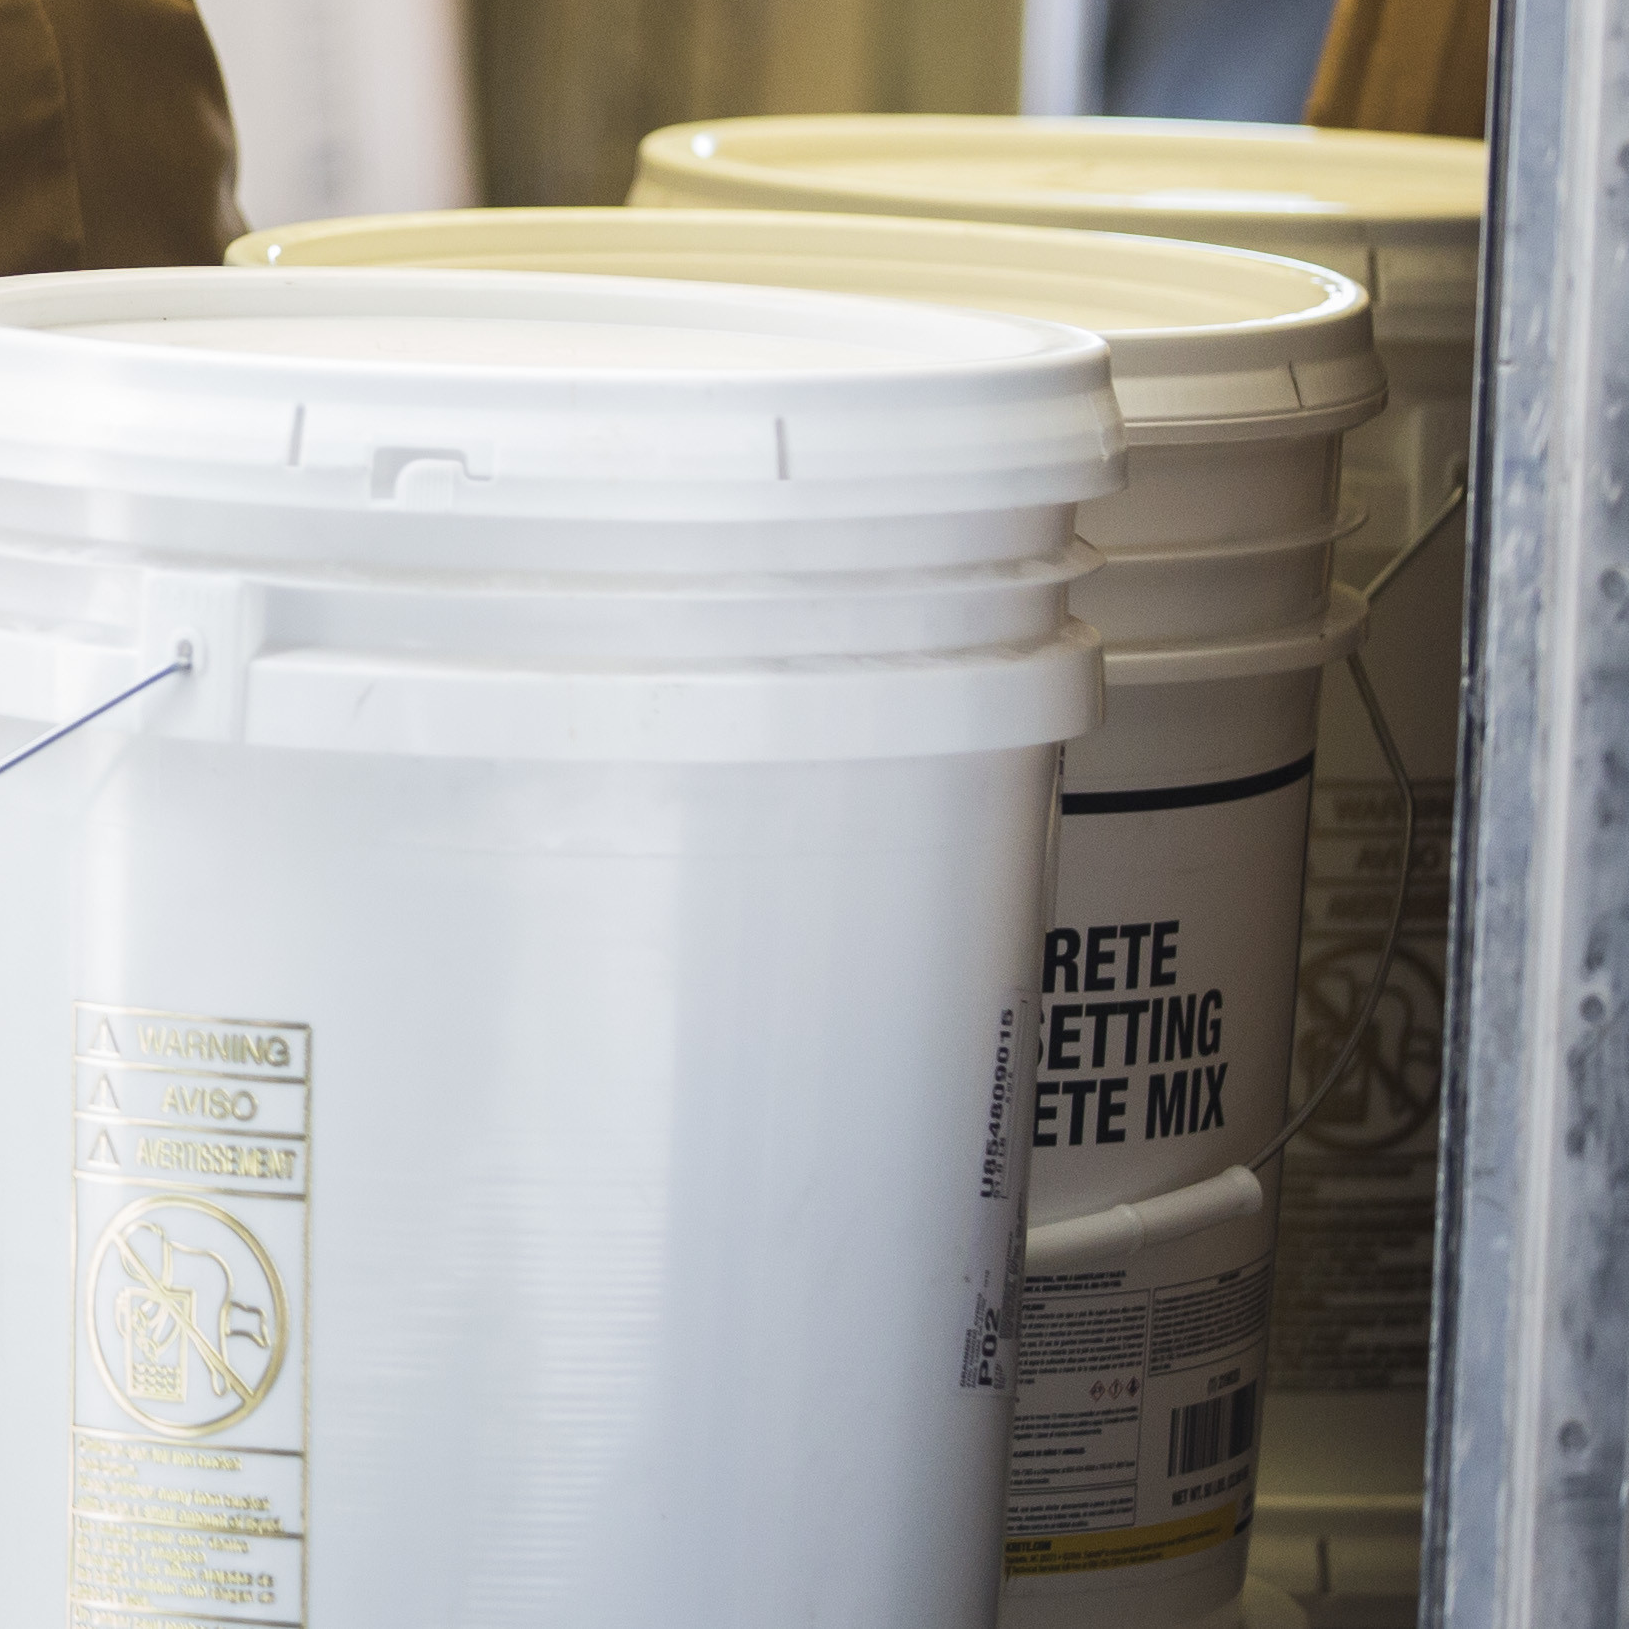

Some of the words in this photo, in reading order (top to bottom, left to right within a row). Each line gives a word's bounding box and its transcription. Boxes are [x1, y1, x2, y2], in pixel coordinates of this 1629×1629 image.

[1042, 920, 1179, 993] RETE
[136, 1024, 291, 1068] WARNING
[1038, 988, 1223, 1070] ETTING
[161, 1084, 259, 1122] AVISO
[1033, 1077, 1129, 1147] ETE
[1145, 1062, 1228, 1140] MIX
[136, 1137, 297, 1180] AVERTISSEMENT
[978, 1308, 1000, 1386] P02
